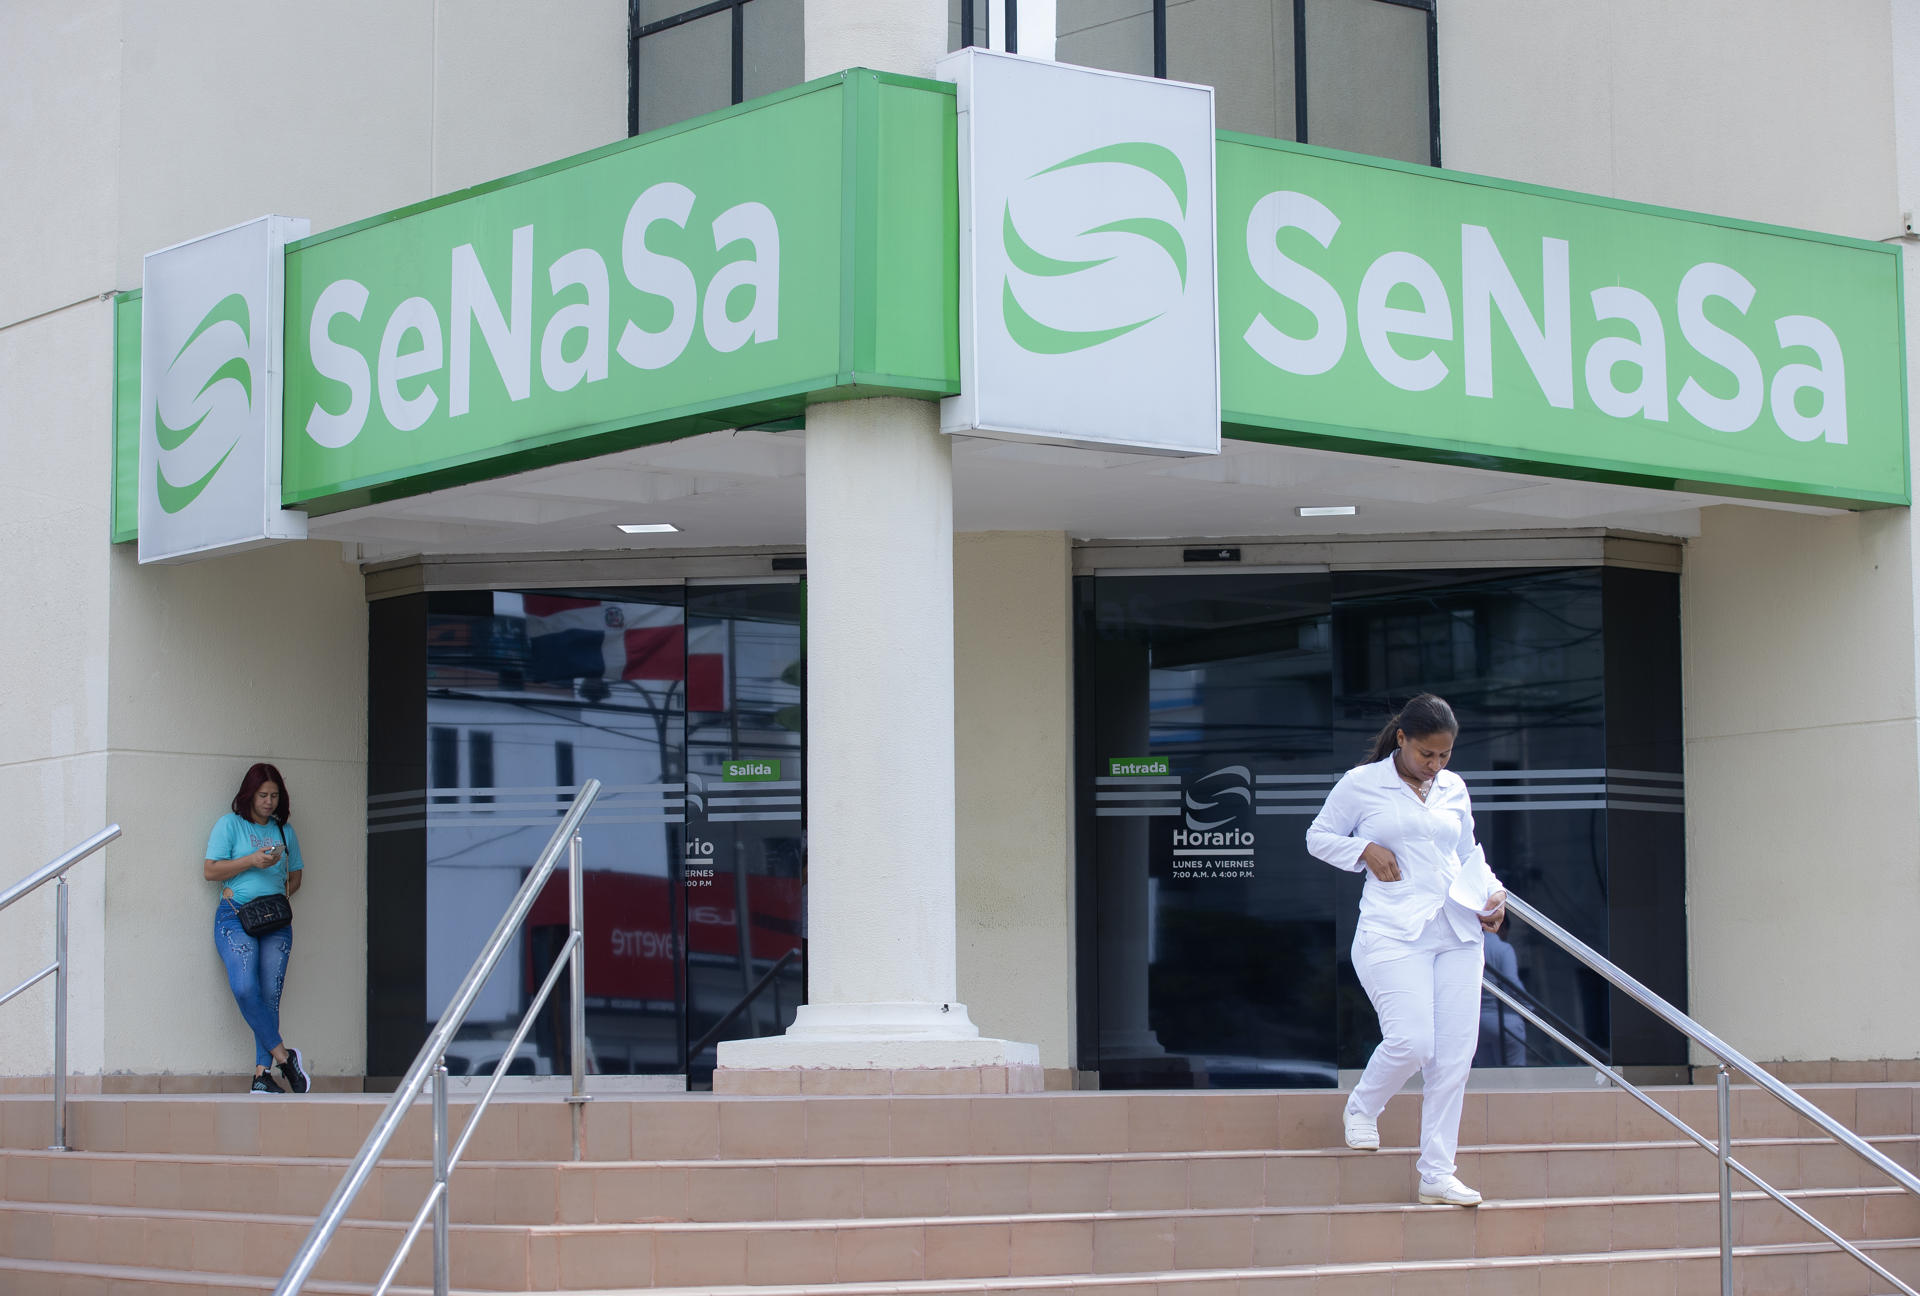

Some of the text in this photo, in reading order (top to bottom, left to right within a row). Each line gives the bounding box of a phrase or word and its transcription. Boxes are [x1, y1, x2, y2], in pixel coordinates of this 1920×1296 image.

[304, 181, 782, 448] SeNaSa
[1242, 190, 1849, 445] SeNaSa
[729, 764, 772, 776] Salida
[1111, 761, 1167, 775] Entrada
[1173, 828, 1255, 846] Horario
[1172, 860, 1255, 869] LUNES A VIERNES
